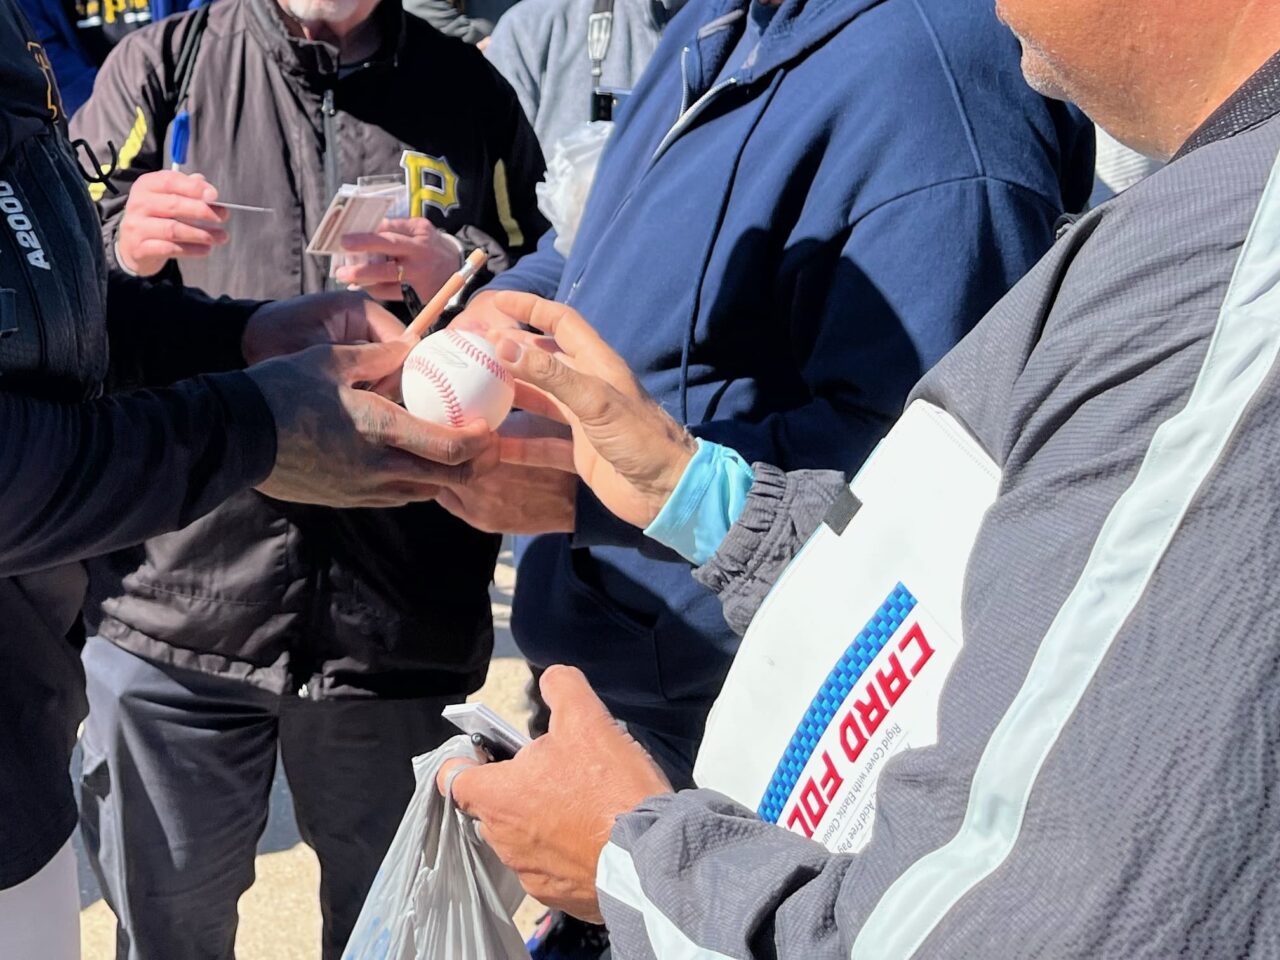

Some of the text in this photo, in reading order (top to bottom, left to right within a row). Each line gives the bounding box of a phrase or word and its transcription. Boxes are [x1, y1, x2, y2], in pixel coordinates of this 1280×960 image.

[399, 150, 459, 218] P
[839, 622, 935, 763] CARD
[880, 722, 902, 750] Rigid
[865, 746, 885, 774] Cover
[851, 773, 868, 793] with
[836, 791, 856, 819] Elastic
[858, 799, 875, 824] Acid
[822, 818, 840, 845] Closur
[847, 818, 864, 840] Free
[836, 838, 853, 854] Pag
